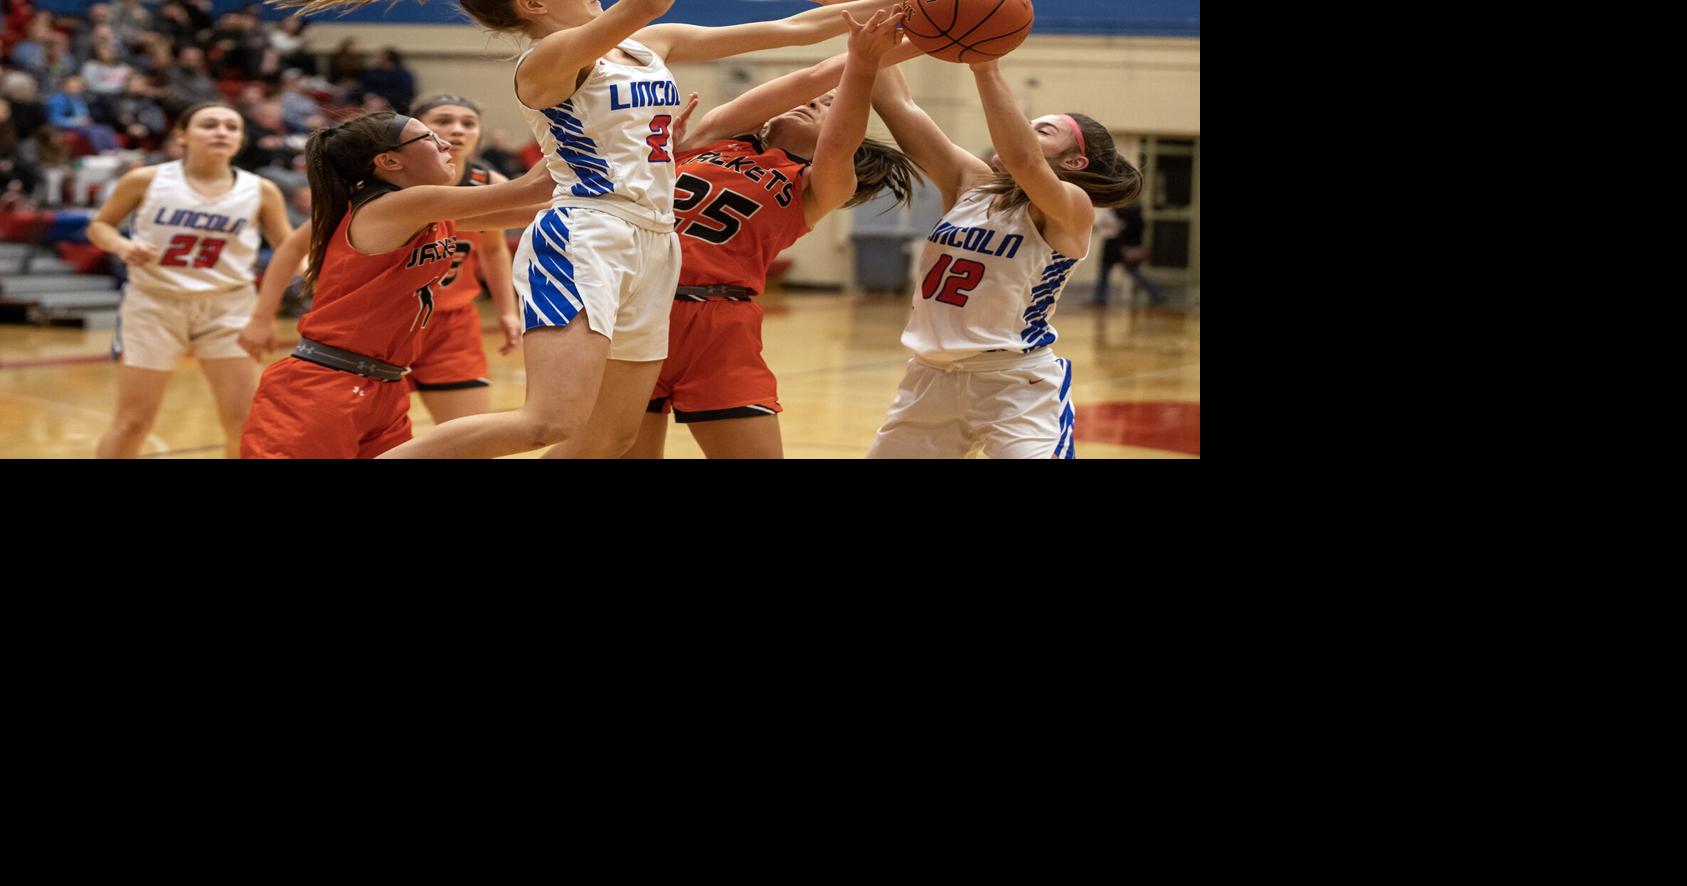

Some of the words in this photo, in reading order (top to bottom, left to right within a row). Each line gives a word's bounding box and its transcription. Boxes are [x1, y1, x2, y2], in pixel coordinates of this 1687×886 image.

[646, 114, 672, 163] 2
[154, 206, 248, 235] LINCOLN
[673, 172, 763, 245] 25
[158, 233, 226, 269] 23
[921, 253, 986, 308] 12
